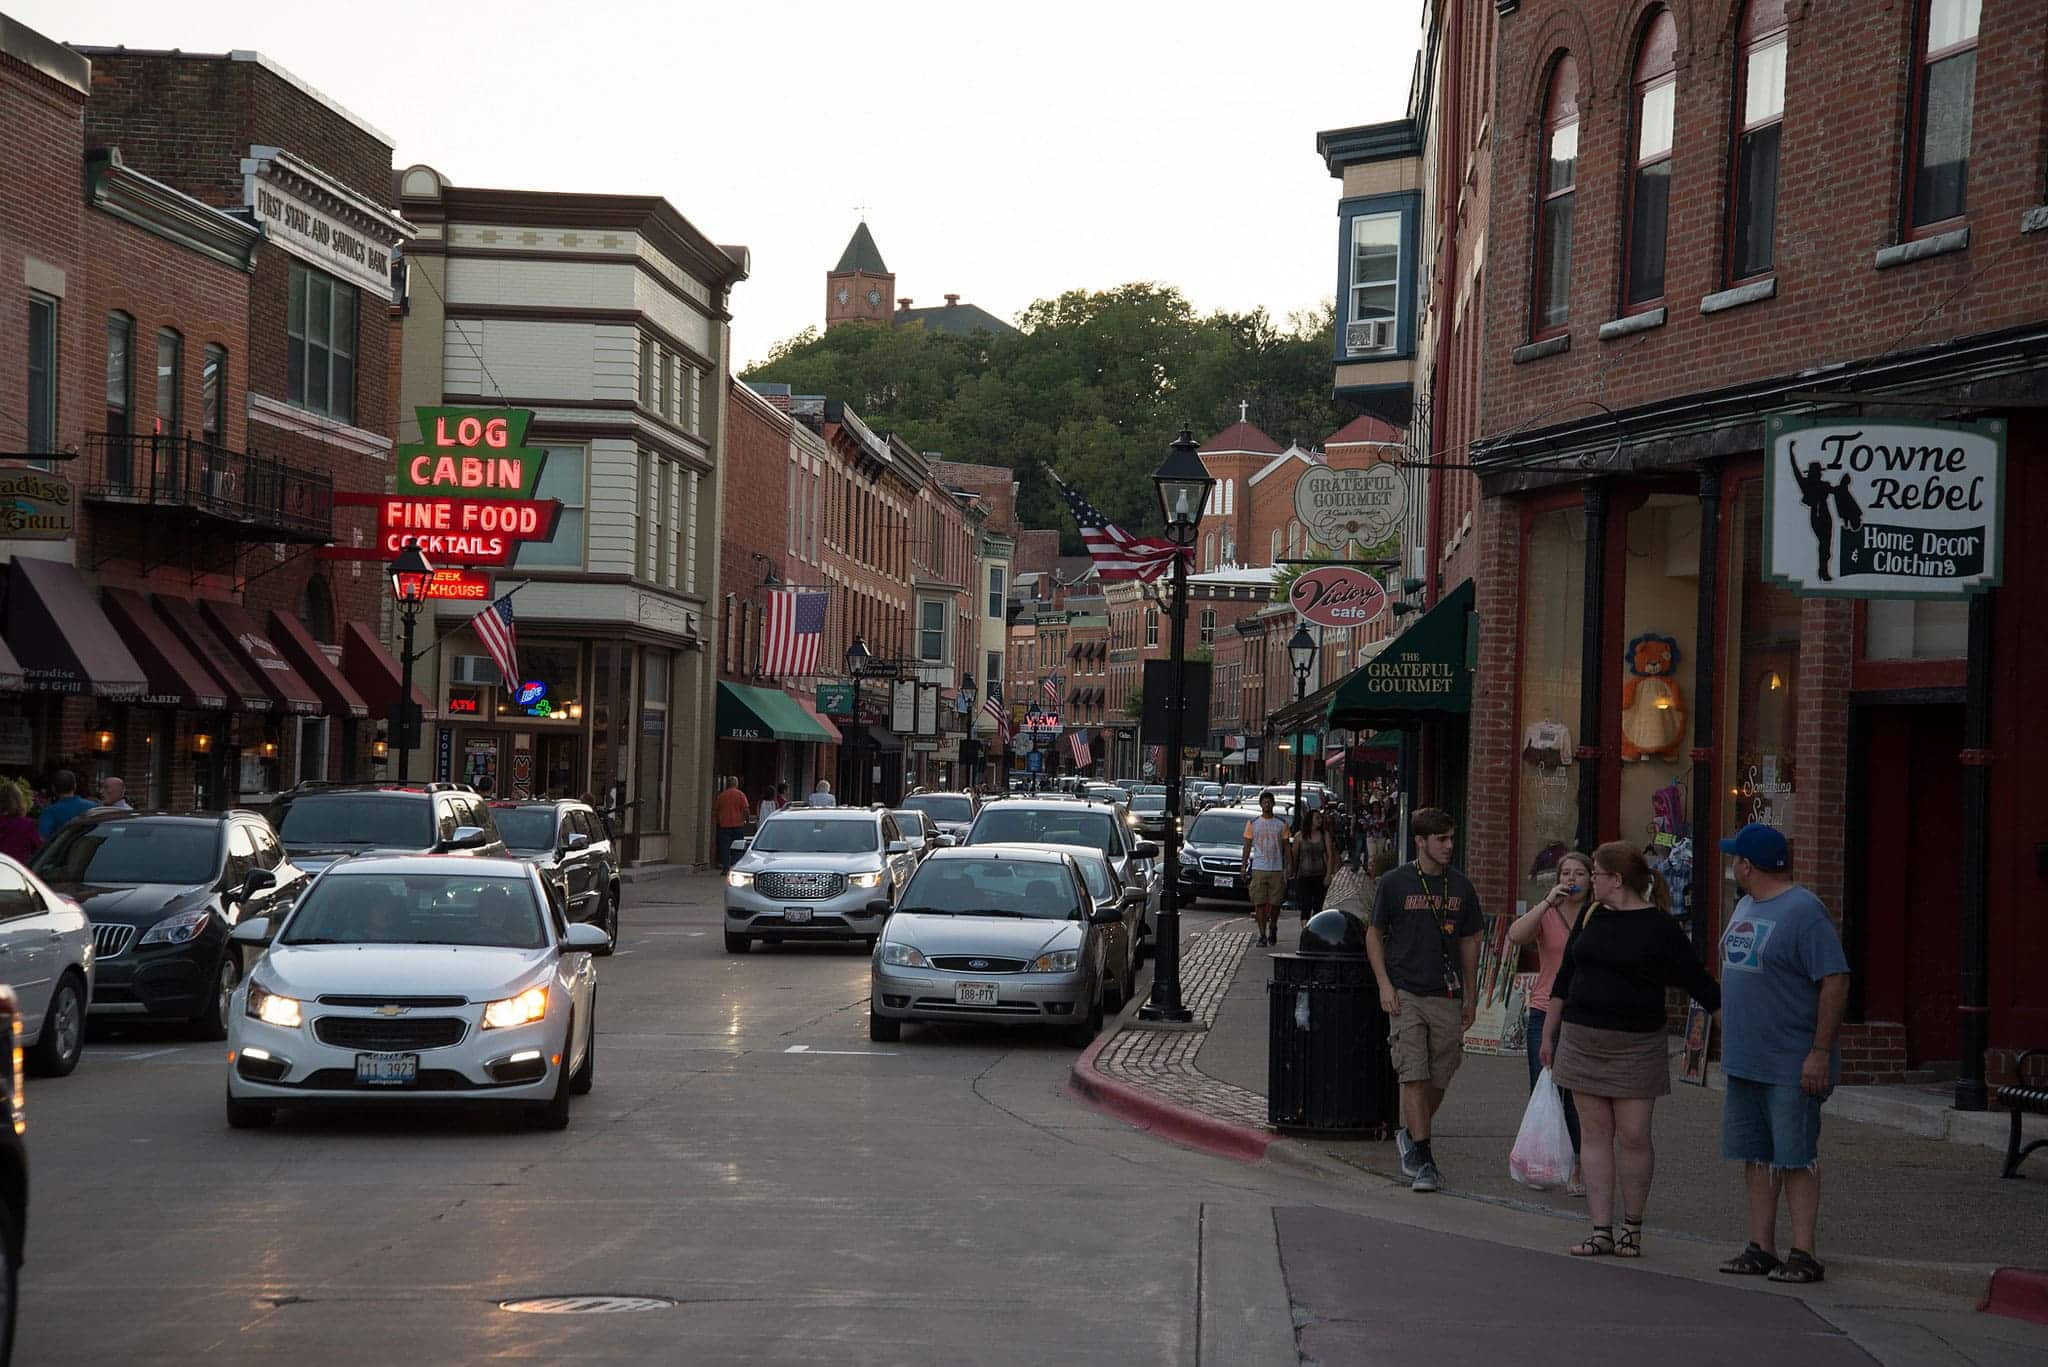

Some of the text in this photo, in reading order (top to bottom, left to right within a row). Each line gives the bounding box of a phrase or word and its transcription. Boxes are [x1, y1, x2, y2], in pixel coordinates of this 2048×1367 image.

[258, 188, 388, 277] FIRST STATE AND SAVINGS BANK
[436, 416, 508, 448] LOG
[1821, 431, 1967, 473] Towne
[410, 455, 522, 489] CABIN
[1310, 476, 1395, 492] GRATEFUL
[1868, 475, 1985, 512] Rebel
[1313, 492, 1392, 507] GOURMET
[387, 502, 537, 533] FINE FOOD
[387, 534, 503, 555] COCKTAILS
[1864, 527, 1980, 557] Home Decor
[1873, 551, 1957, 576] Clothing
[1294, 579, 1381, 612] Victory
[1330, 606, 1366, 618] cafe
[1401, 652, 1419, 661] THE
[1368, 664, 1454, 677] GRATEFUL
[52, 681, 80, 693] Grill
[1368, 679, 1453, 692] GOURMET
[142, 695, 180, 703] CABIN
[732, 729, 759, 737] ELKS
[1743, 765, 1791, 799] Something
